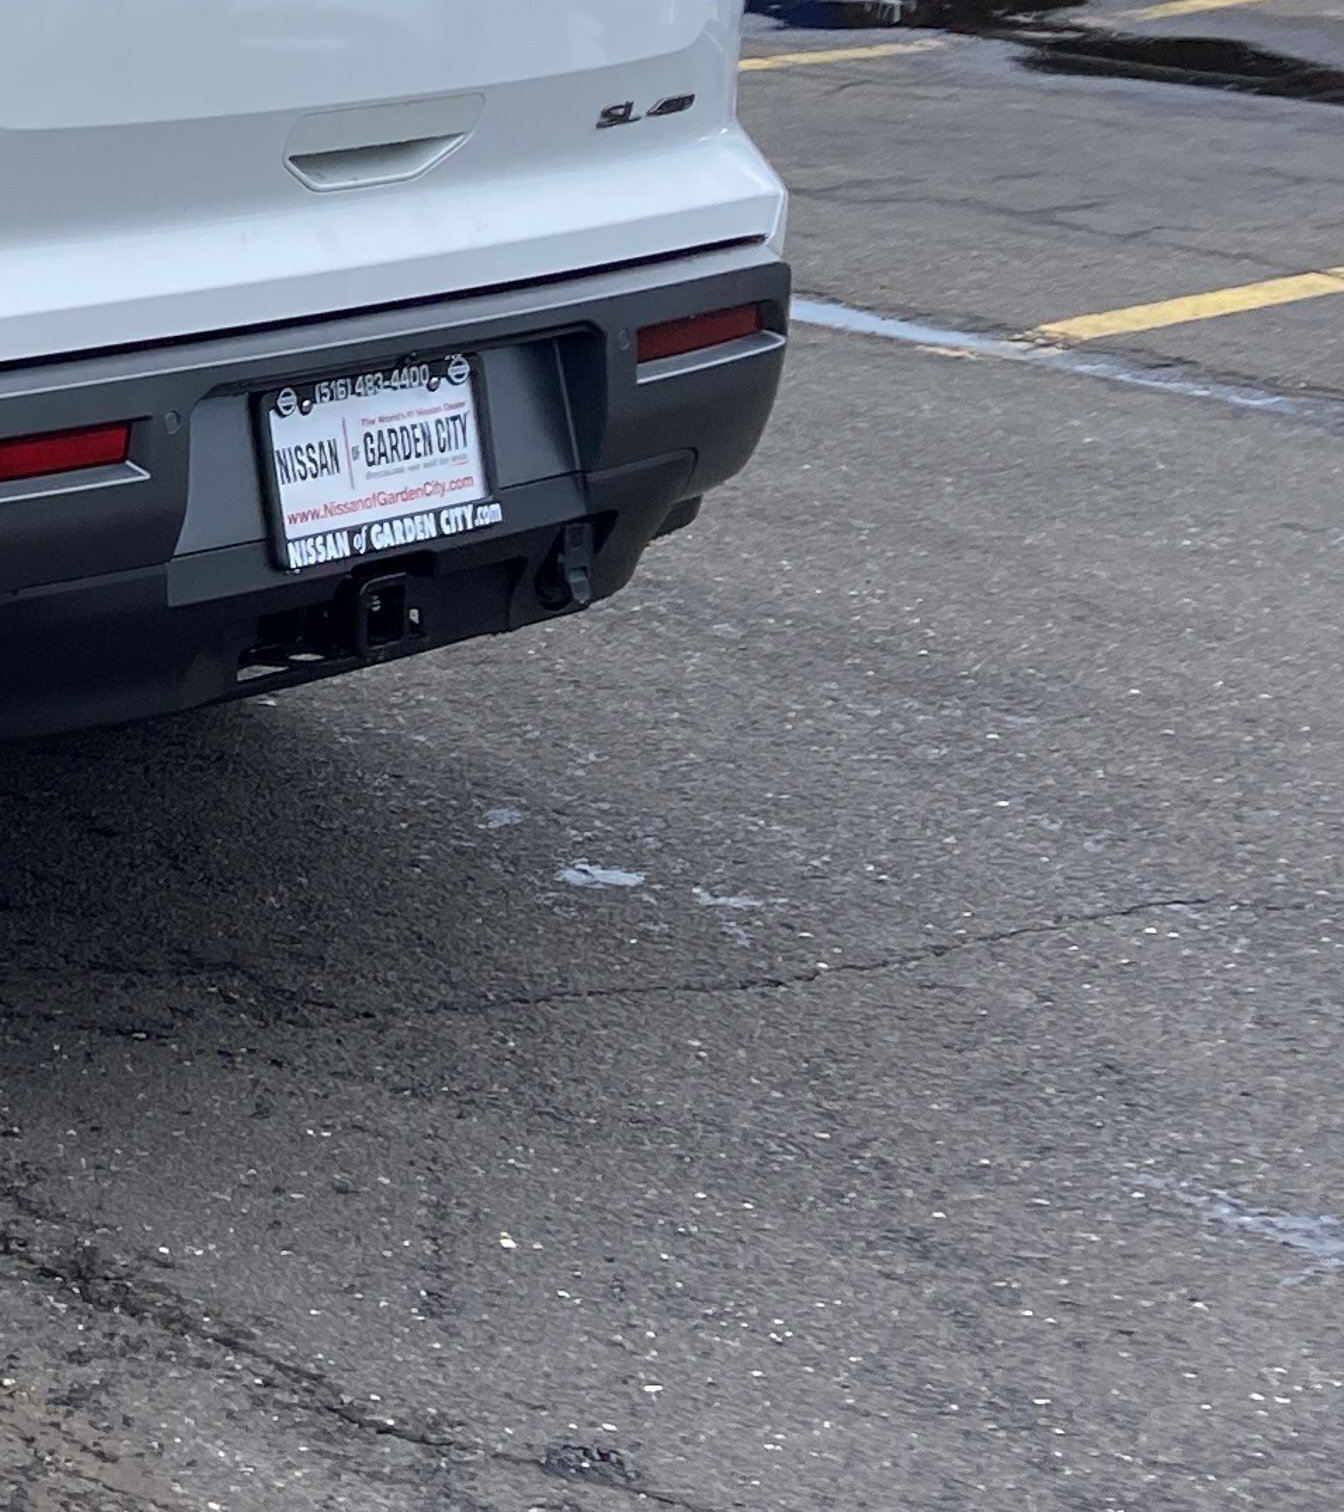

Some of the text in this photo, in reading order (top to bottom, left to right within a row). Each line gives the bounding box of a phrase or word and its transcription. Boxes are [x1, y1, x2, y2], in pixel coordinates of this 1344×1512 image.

[596, 100, 642, 130] SL
[314, 363, 430, 404] (516) 483-4400
[275, 437, 341, 486] NISSAN
[363, 420, 434, 468] GARDEN
[435, 411, 470, 454] CITY
[287, 475, 475, 526] www.NissanofGardenCity.com
[287, 530, 351, 569] NISSAN
[353, 525, 368, 555] of
[369, 511, 437, 551] GARDEN
